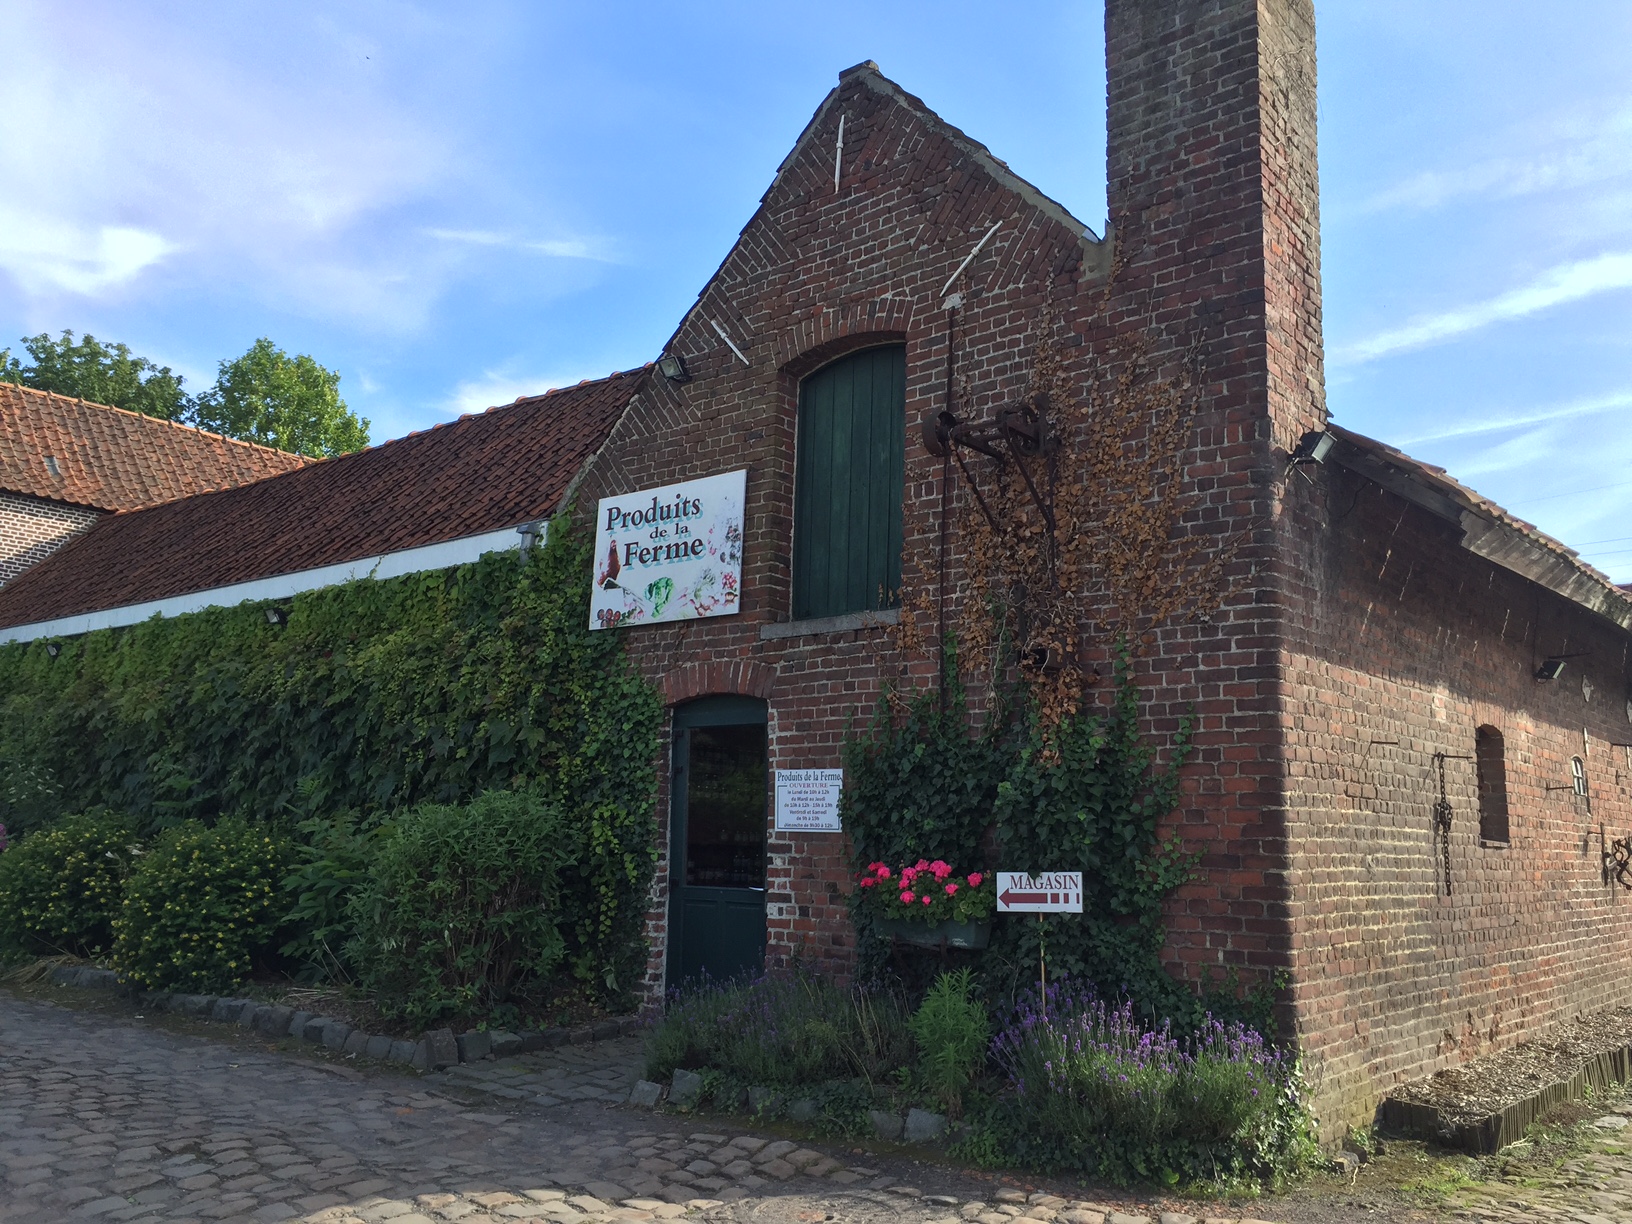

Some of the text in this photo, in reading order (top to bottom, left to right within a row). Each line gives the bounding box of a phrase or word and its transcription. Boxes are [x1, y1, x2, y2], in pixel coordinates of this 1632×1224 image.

[605, 493, 701, 532] Produits
[649, 522, 689, 540] de la
[622, 538, 704, 567] Ferme
[777, 771, 841, 781] Produits de la Ferme
[1009, 874, 1080, 890] MAGASIN
